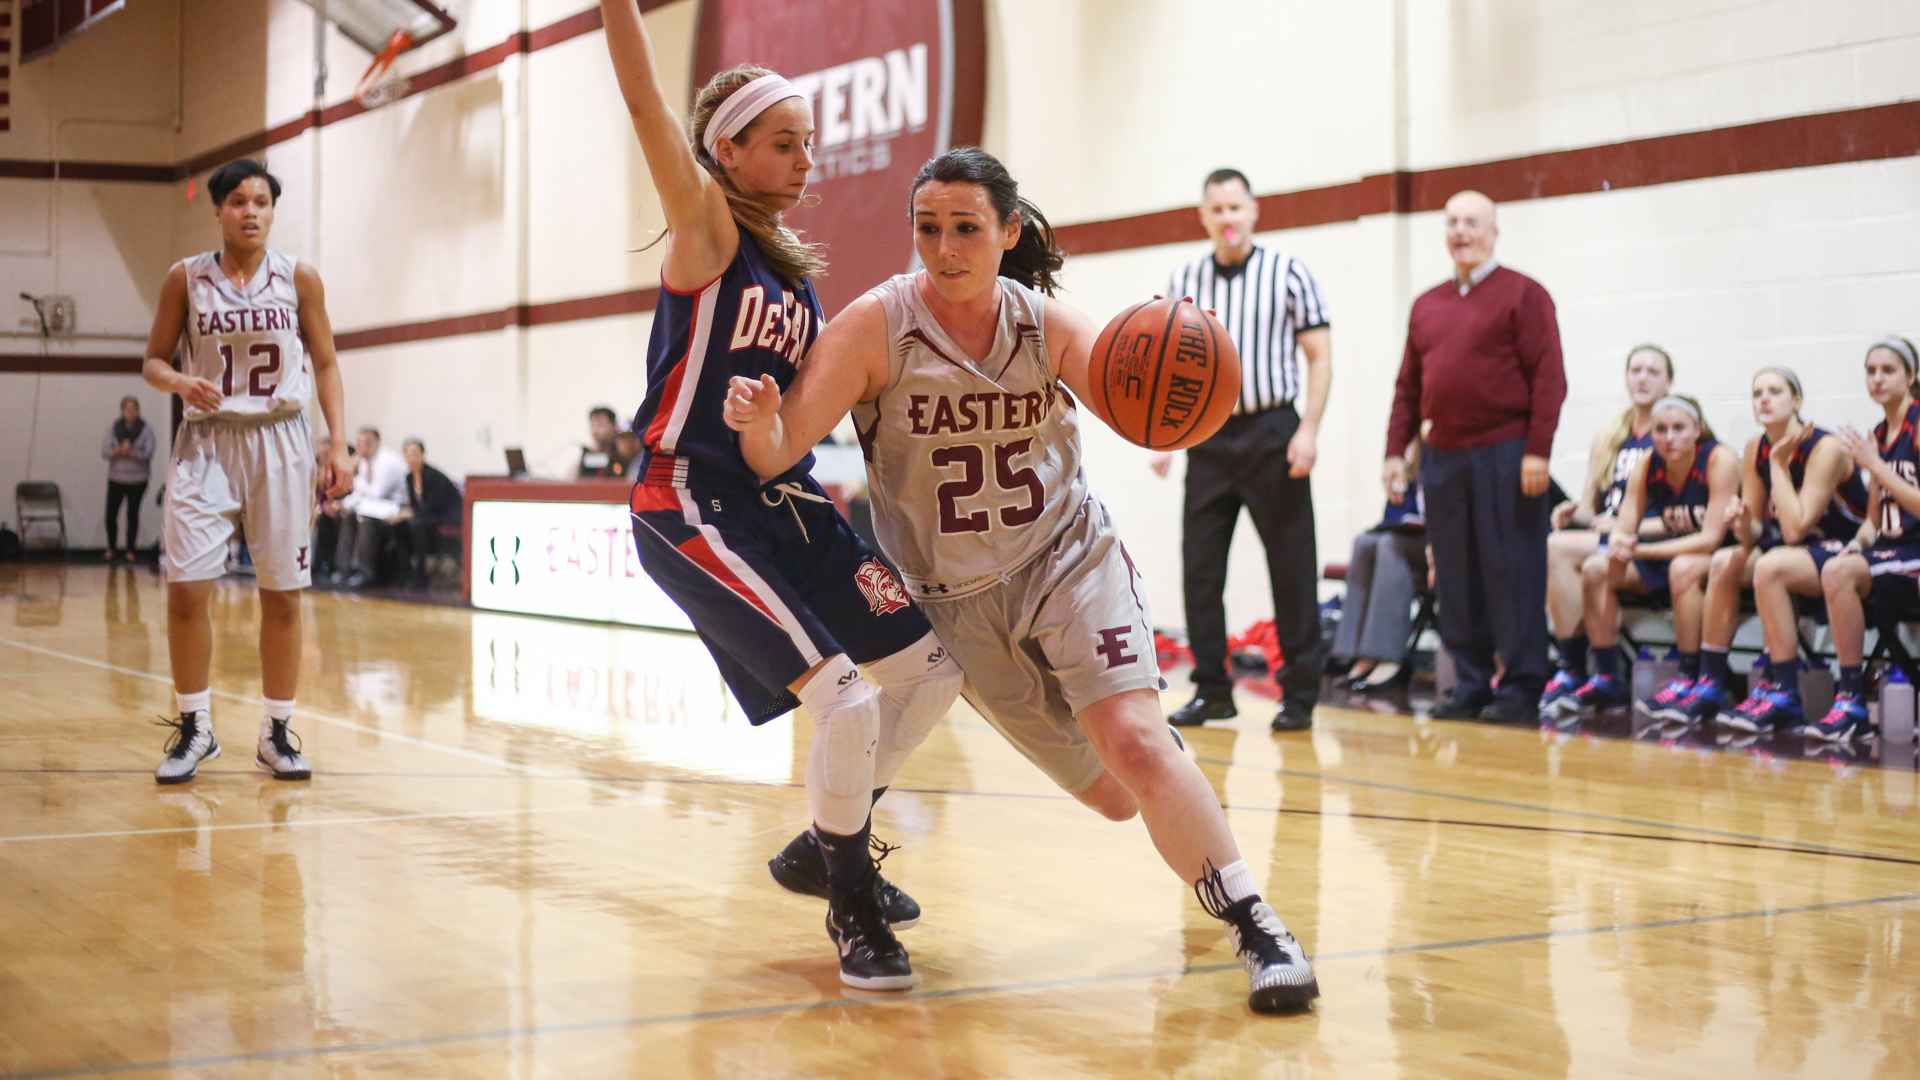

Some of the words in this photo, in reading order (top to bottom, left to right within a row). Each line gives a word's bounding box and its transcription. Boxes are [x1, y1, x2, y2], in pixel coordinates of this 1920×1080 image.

[788, 42, 928, 147] TERN
[197, 308, 291, 336] EASTERN
[1175, 322, 1208, 368] THE
[219, 343, 280, 397] 12
[1160, 373, 1204, 430] ROCK
[930, 436, 1046, 535] 25
[546, 526, 647, 579] EASTE
[1094, 624, 1139, 672] E
